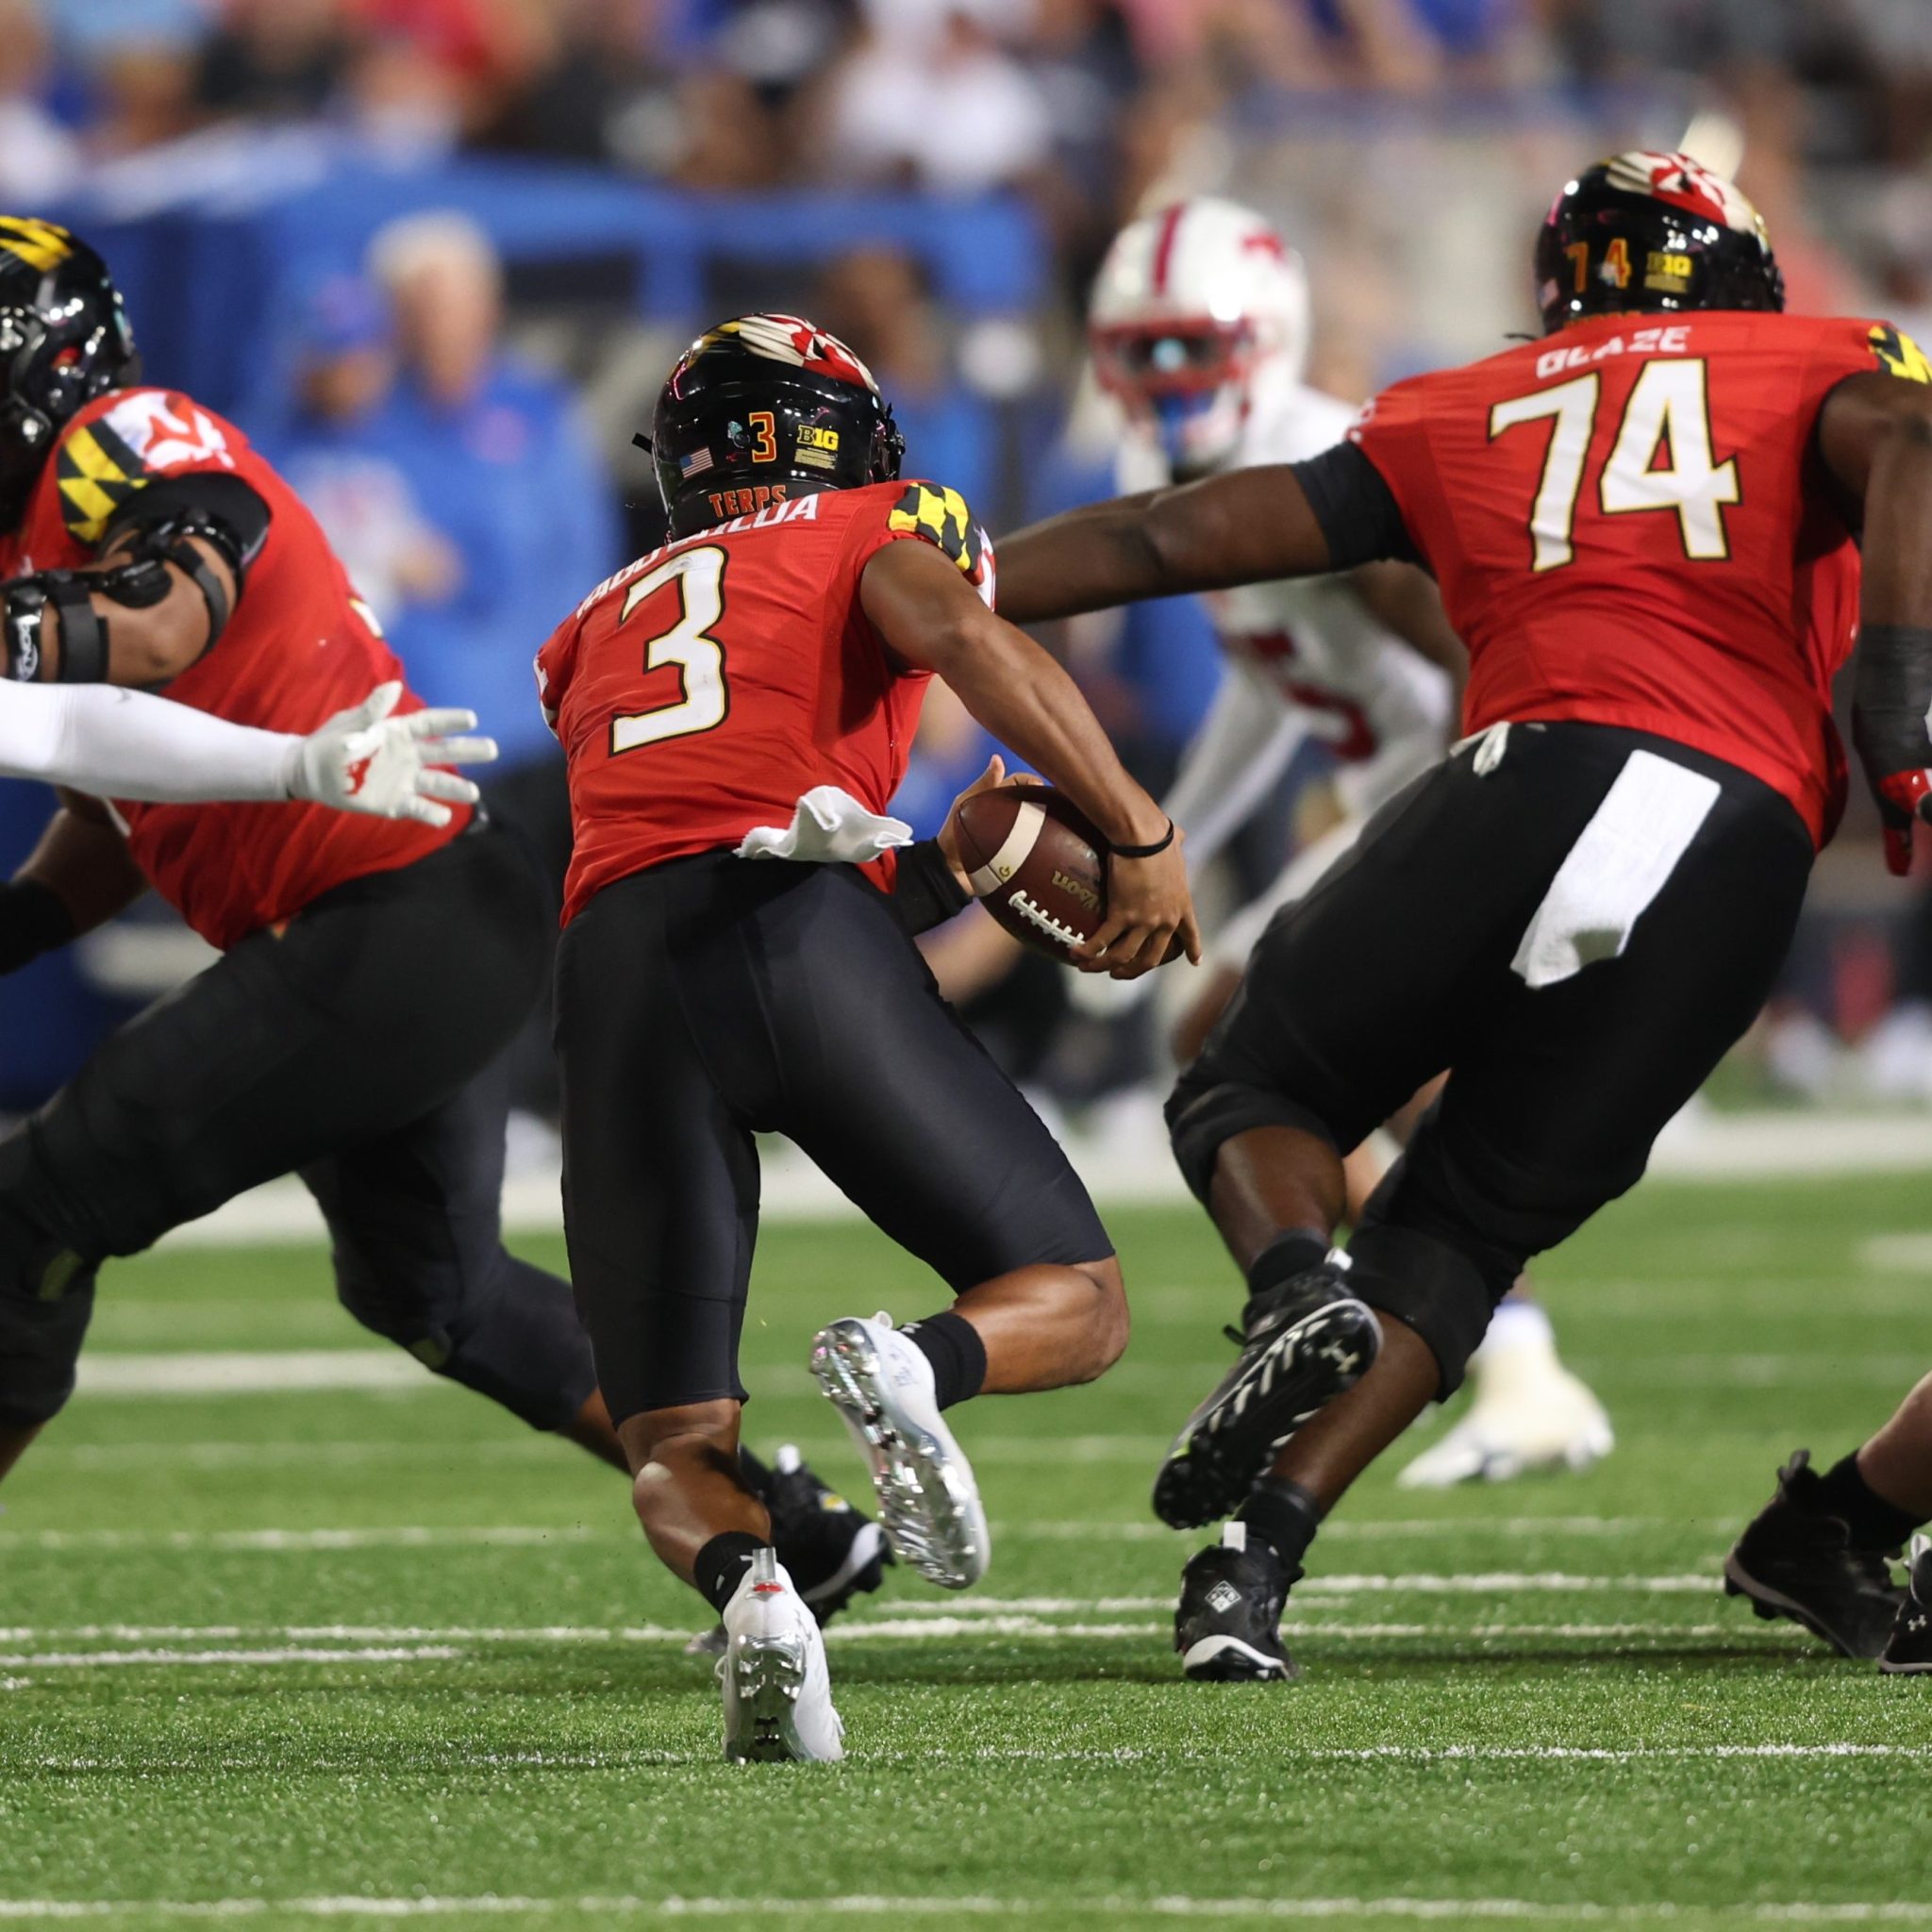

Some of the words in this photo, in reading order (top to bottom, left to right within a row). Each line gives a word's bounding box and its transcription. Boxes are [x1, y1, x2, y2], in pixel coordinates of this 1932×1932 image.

[708, 485, 787, 518] TERPS
[749, 411, 776, 462] 3
[1488, 358, 1742, 573] 74
[608, 541, 729, 758] 3
